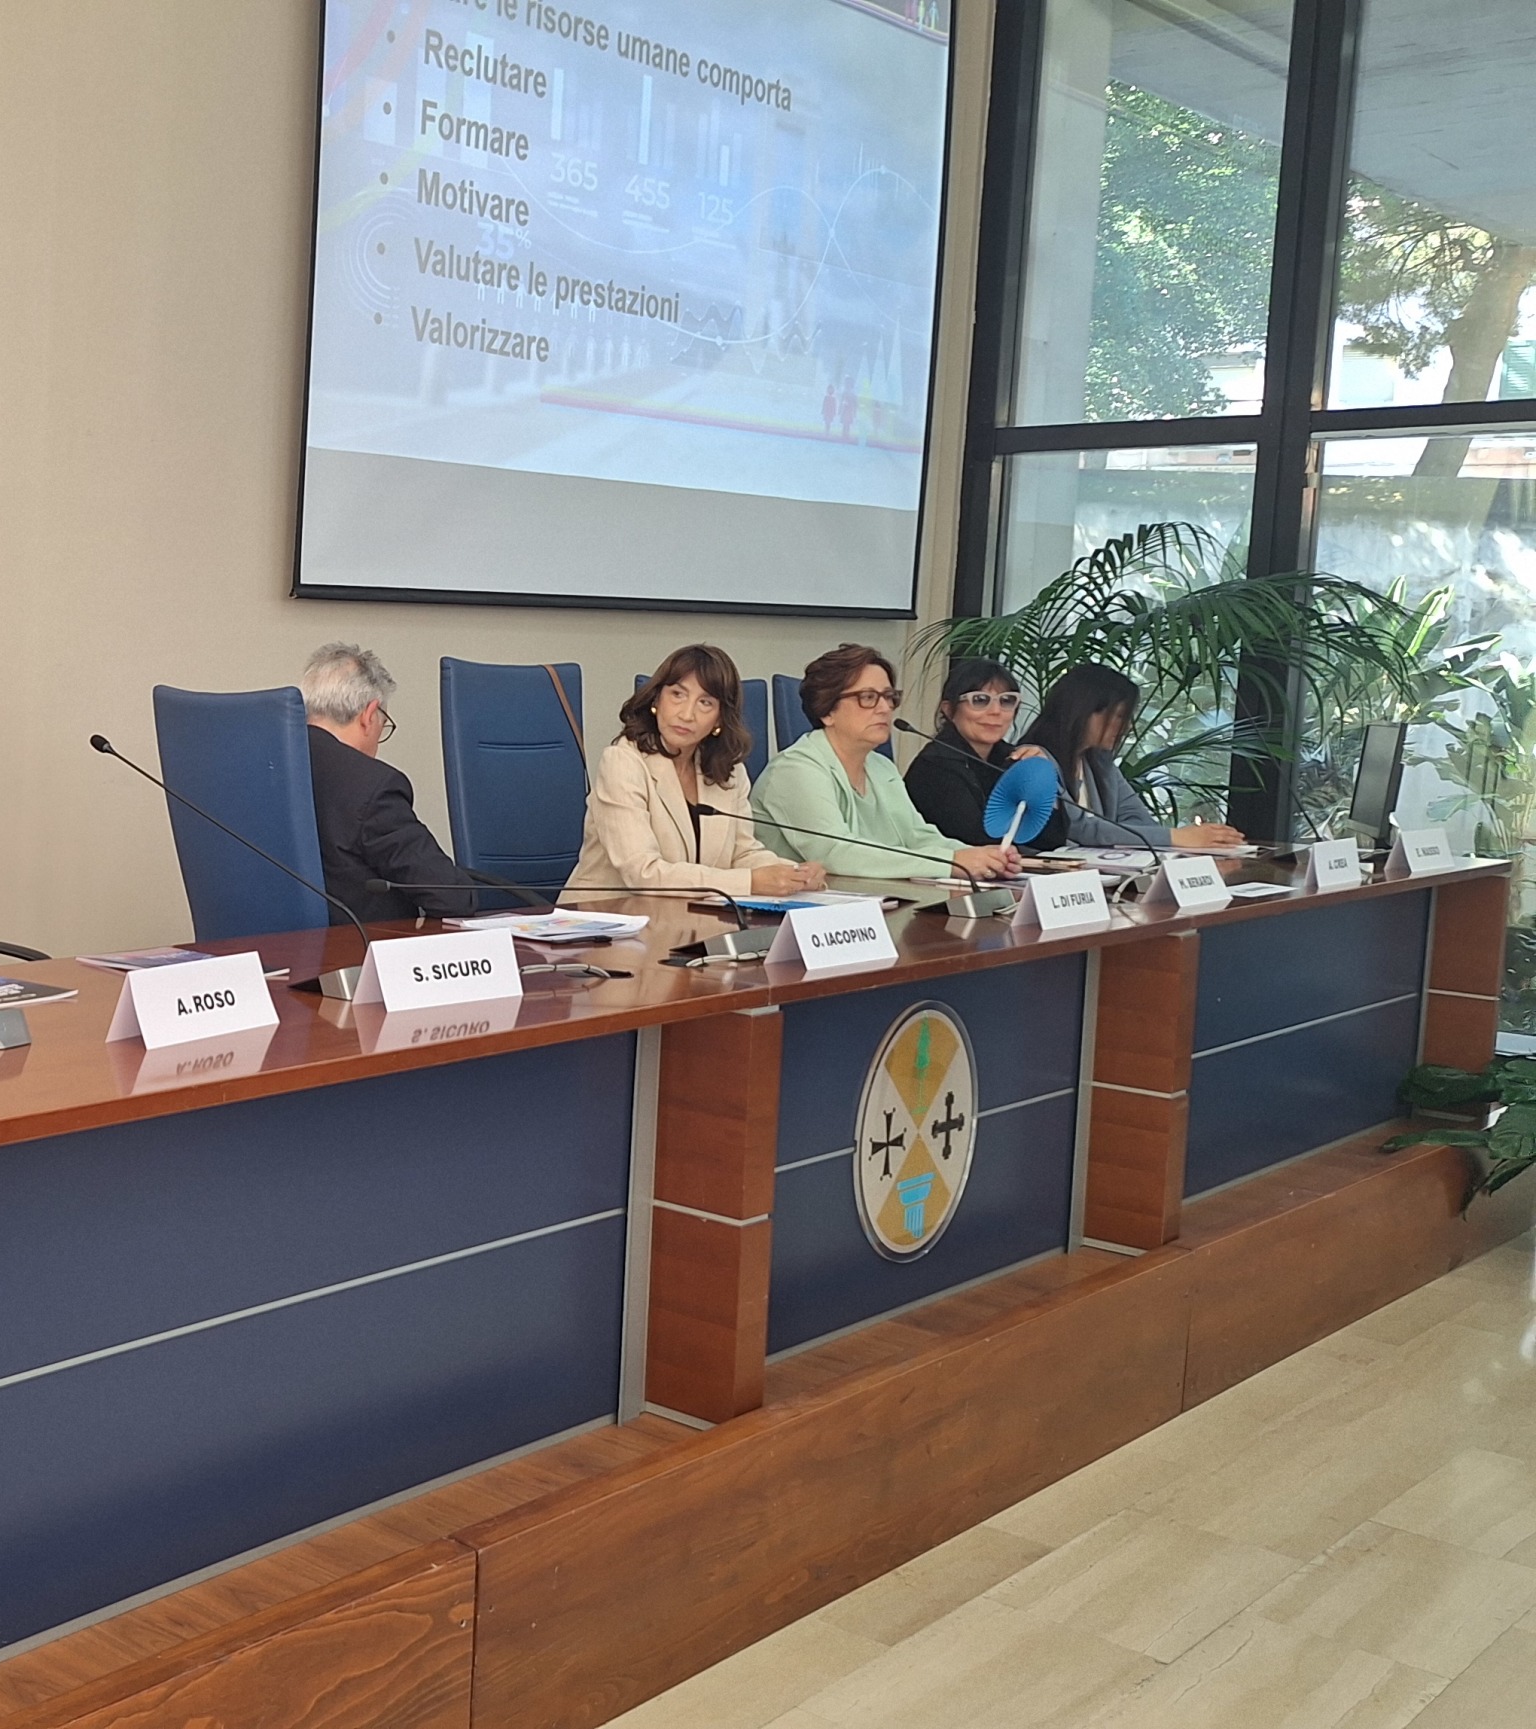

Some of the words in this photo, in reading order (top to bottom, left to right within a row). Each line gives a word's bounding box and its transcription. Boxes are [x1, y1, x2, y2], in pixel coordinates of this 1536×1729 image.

[424, 28, 547, 98] Reclutare
[526, 0, 610, 51] risorse
[617, 31, 690, 77] umane
[697, 59, 792, 112] comporta
[420, 98, 529, 161] Formare
[550, 152, 598, 191] 365
[417, 167, 530, 227] Motivare
[625, 174, 671, 209] 455
[698, 192, 734, 225] 125
[414, 236, 520, 291] Valutare
[527, 261, 548, 297] le
[555, 274, 680, 324] prestazioni
[411, 305, 550, 363] Valorizzare
[1051, 897, 1060, 909] L.
[1060, 895, 1070, 907] DI
[1070, 892, 1096, 906] FURIA
[811, 934, 824, 948] O.
[824, 927, 877, 946] IACOPINO
[413, 967, 429, 982] S.
[432, 959, 492, 980] SICURO
[177, 998, 192, 1016] A.
[194, 990, 236, 1013] ROSO
